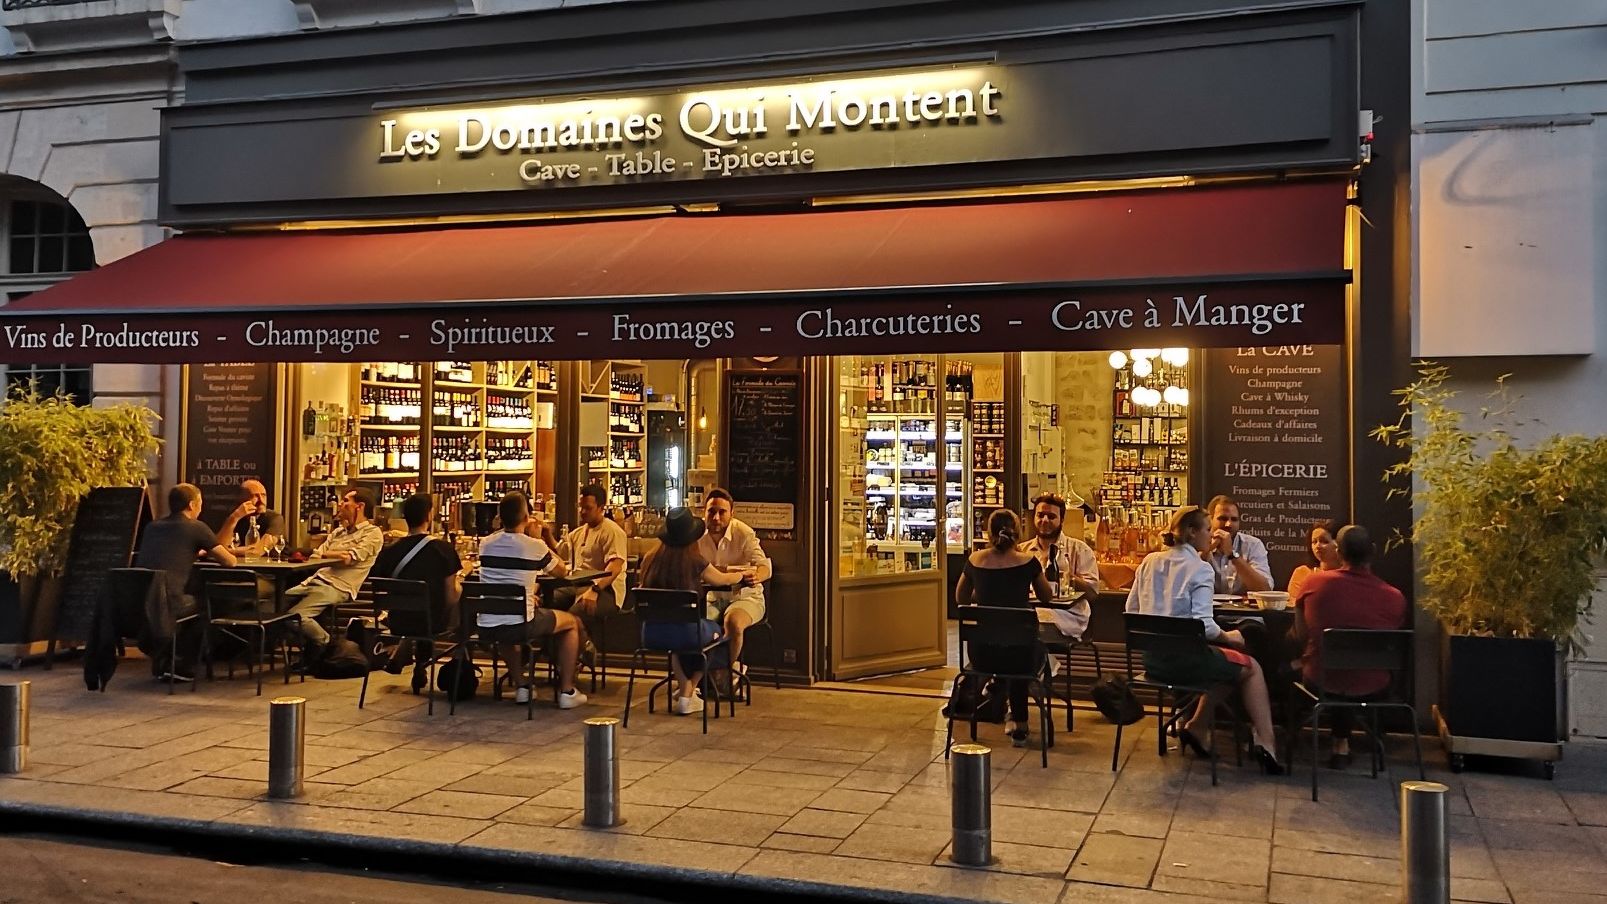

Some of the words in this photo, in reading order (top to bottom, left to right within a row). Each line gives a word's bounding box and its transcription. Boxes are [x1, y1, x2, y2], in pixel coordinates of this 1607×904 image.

[380, 119, 441, 159] Les
[455, 107, 663, 153] Domaines
[679, 97, 768, 147] Qui
[786, 81, 999, 131] Montent
[519, 159, 581, 182] Cave
[605, 151, 676, 177] Table
[702, 141, 815, 176] Epicerie
[4, 324, 47, 349] Vins
[52, 323, 75, 348] de
[80, 322, 199, 348] Producteurs
[245, 320, 380, 353] Champagne
[430, 318, 555, 353] Spiritueux
[611, 314, 735, 348] Fromages
[796, 304, 981, 339] Charcuteries
[1051, 301, 1133, 331] Cave
[1144, 299, 1161, 328] à
[1171, 295, 1305, 335] Manger
[1229, 365, 1250, 374] Vins
[1252, 365, 1263, 374] de
[1266, 365, 1321, 376] producteurs
[1247, 379, 1303, 390] Champagne
[1240, 392, 1263, 401] Cave
[1274, 392, 1309, 404] Whisky
[1231, 406, 1264, 416] Rhums
[1267, 406, 1320, 418] d'exception
[1233, 419, 1273, 430] Cadeaux
[1275, 419, 1318, 430] d'affaires
[1228, 433, 1271, 443] Livraison
[1282, 433, 1323, 443] domicile
[207, 459, 240, 470] TABLE
[1224, 459, 1328, 478] L'ÉPICERIE
[1233, 486, 1275, 498] Fromages
[1279, 487, 1319, 497] Fermiers
[1288, 501, 1331, 511] Salaisons
[1240, 513, 1262, 523] Gras
[1264, 514, 1276, 523] de
[1274, 527, 1285, 537] de
[1288, 527, 1298, 538] la
